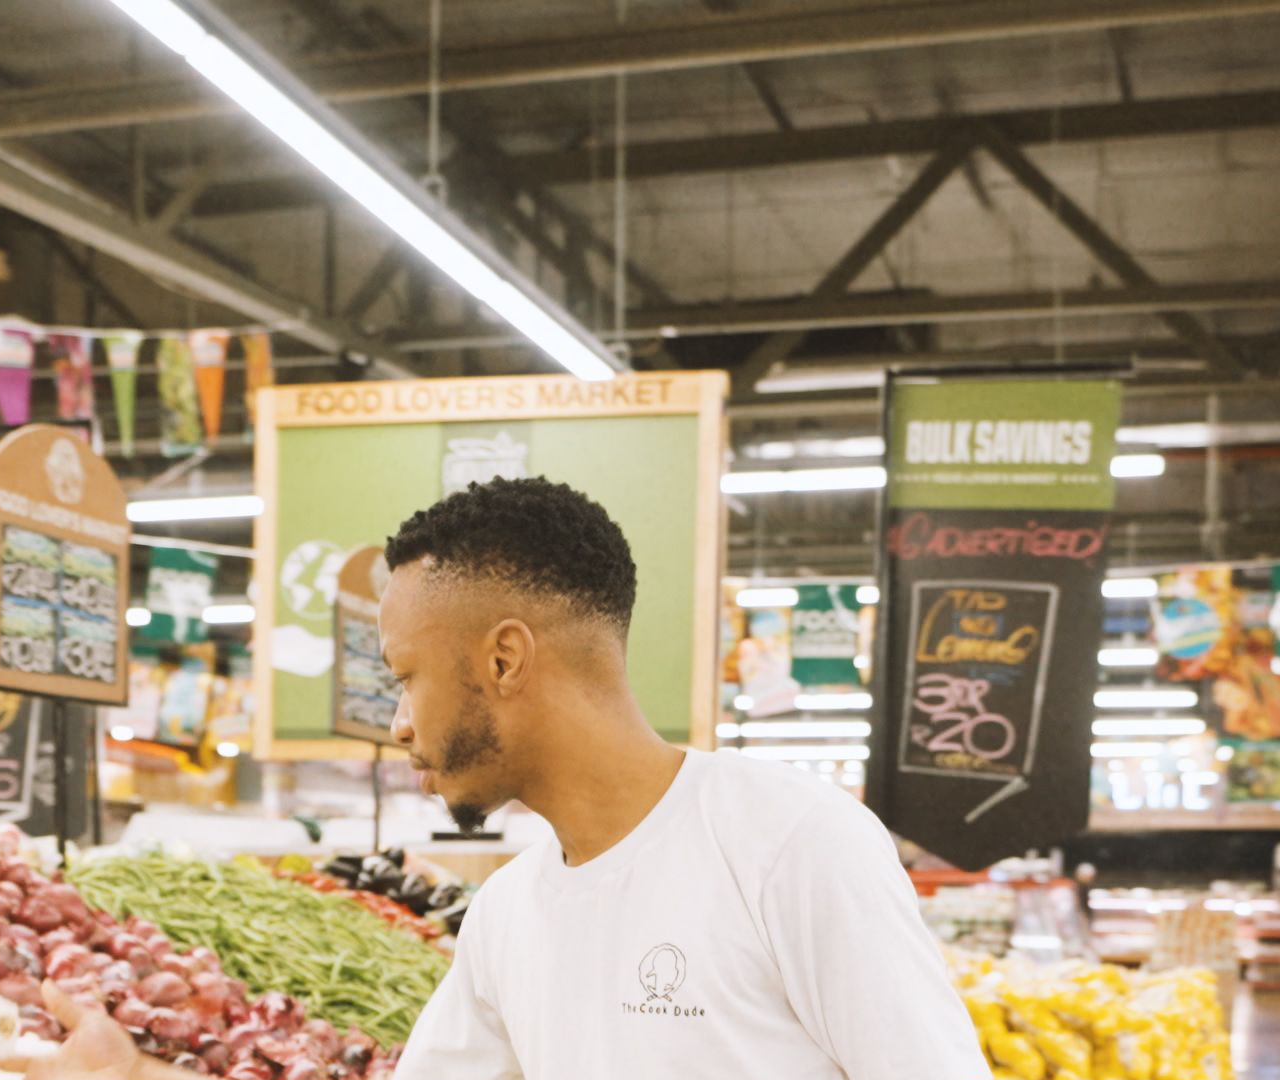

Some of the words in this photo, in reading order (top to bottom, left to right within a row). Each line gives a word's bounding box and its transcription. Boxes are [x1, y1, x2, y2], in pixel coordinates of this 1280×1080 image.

[296, 389, 384, 416] FOOD
[537, 379, 674, 408] MARKET
[906, 420, 972, 463] BULK
[974, 420, 1092, 464] SAVINGS
[639, 1003, 668, 1015] Cook
[674, 1005, 706, 1017] Dude
